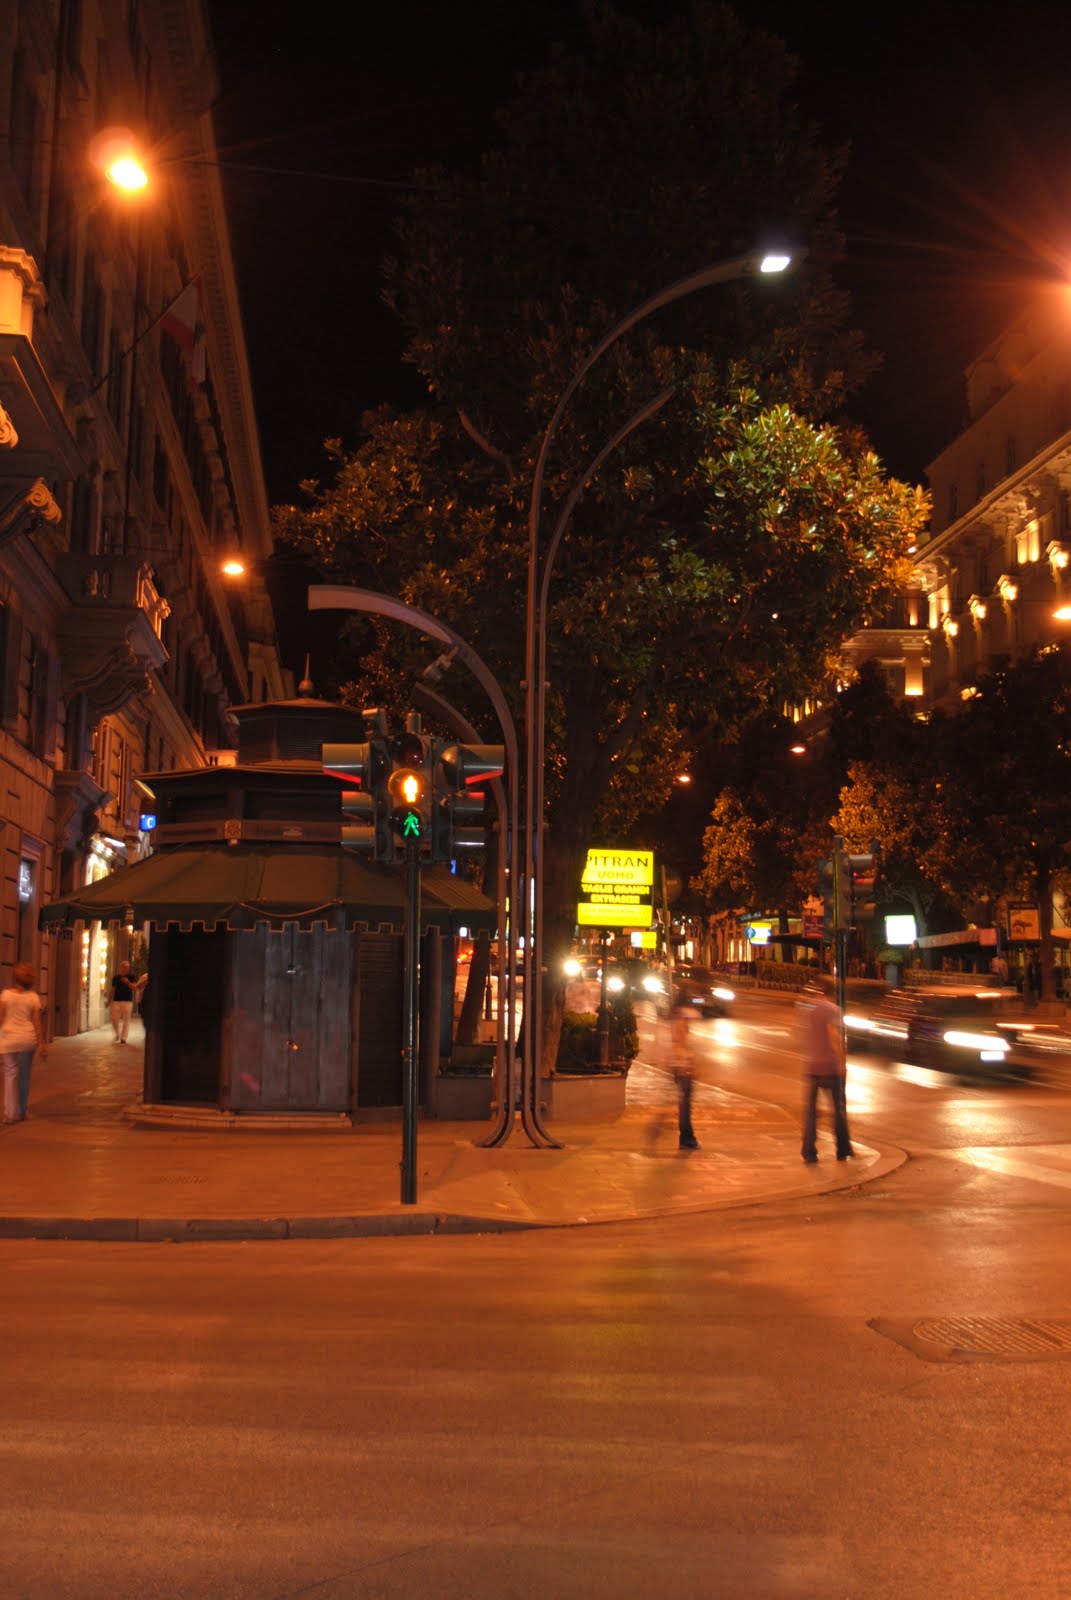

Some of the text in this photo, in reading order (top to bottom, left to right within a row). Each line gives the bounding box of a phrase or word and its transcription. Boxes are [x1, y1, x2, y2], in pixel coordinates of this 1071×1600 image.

[597, 870, 634, 880] UOMO
[581, 884, 650, 895] TAGLIE GRANDI
